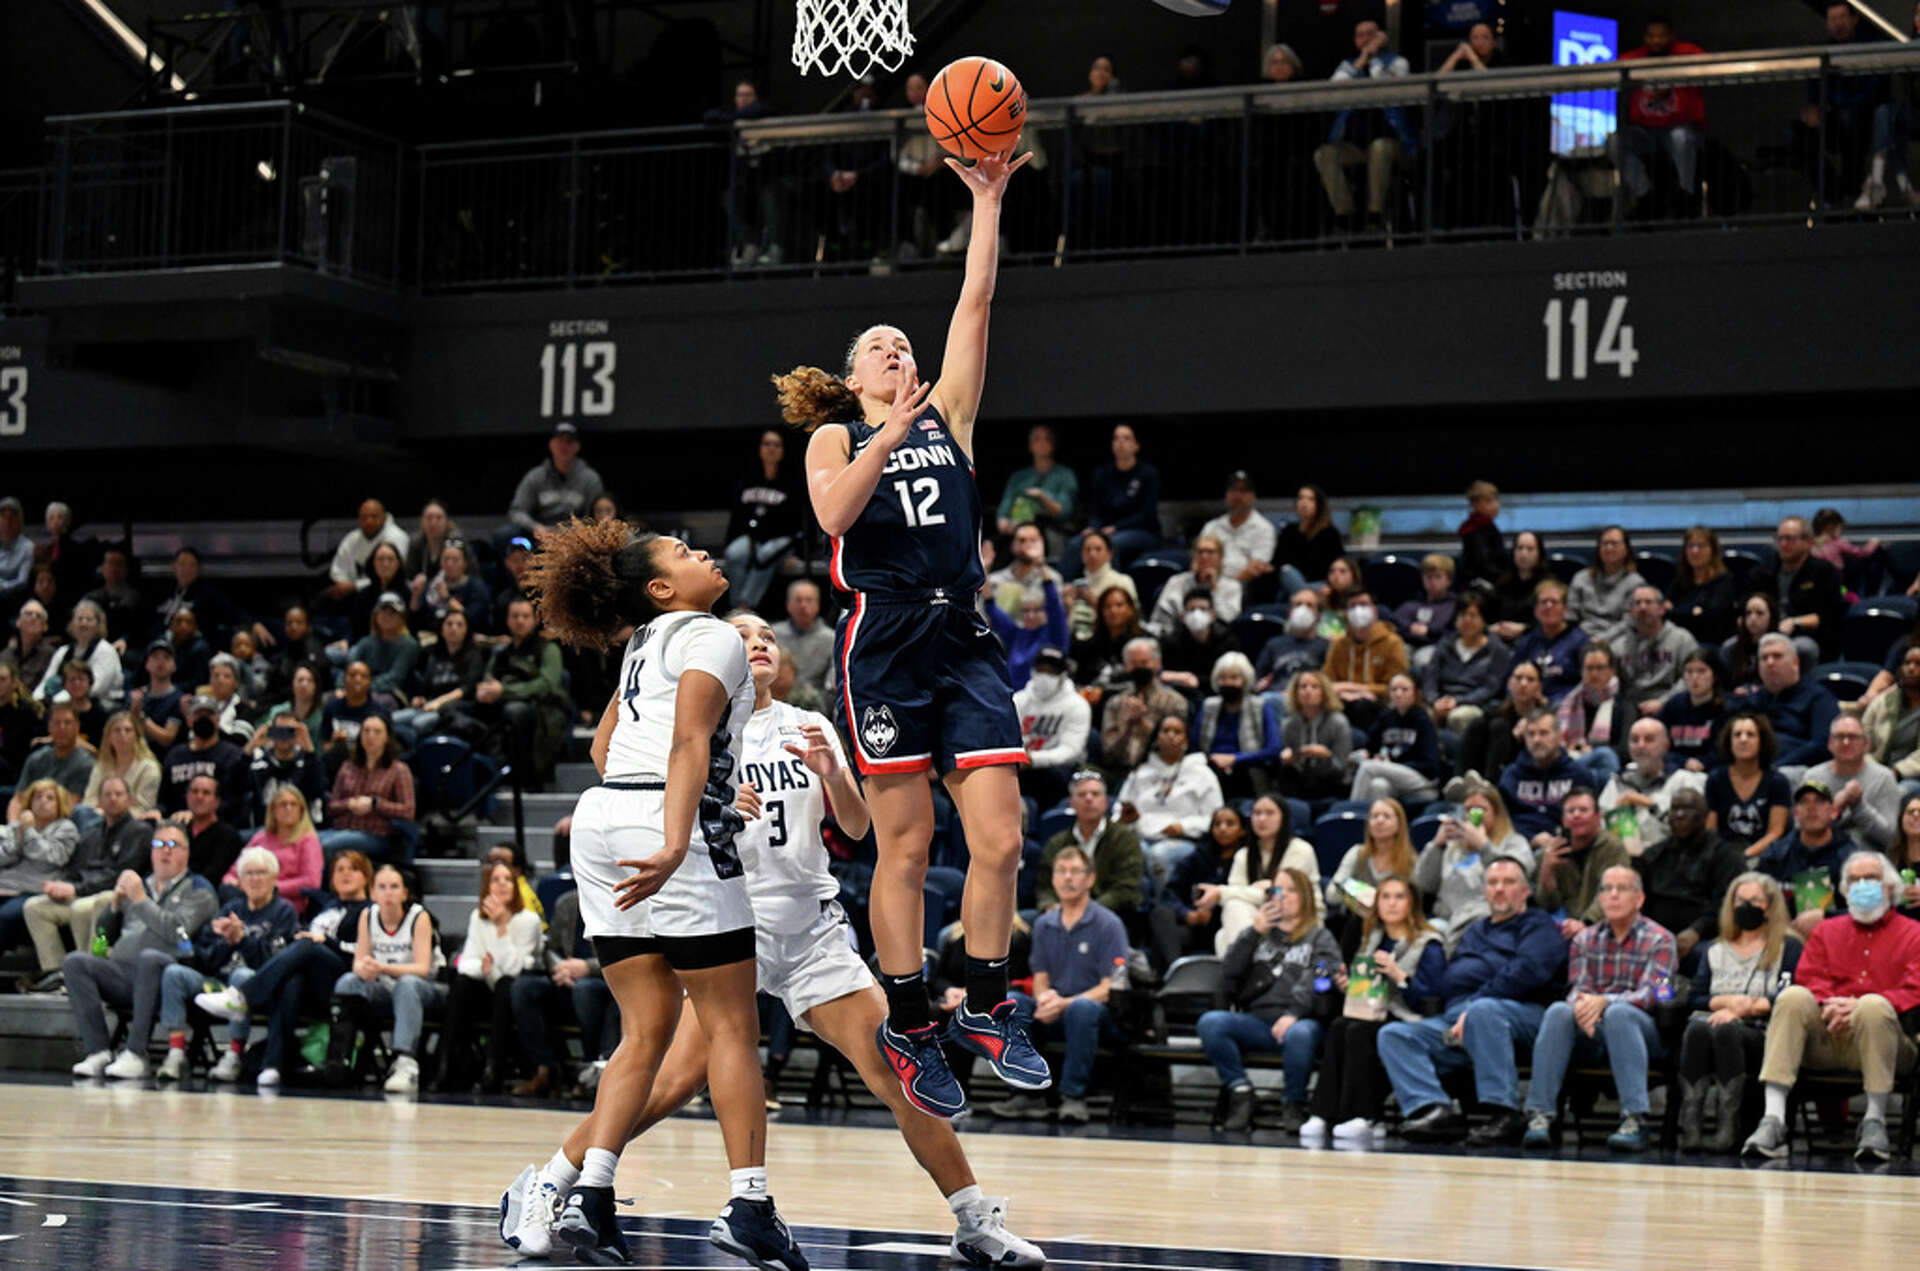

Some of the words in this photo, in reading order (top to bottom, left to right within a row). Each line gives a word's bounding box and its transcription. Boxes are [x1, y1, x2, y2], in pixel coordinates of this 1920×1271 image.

[1553, 270, 1627, 290] SECTION
[549, 319, 609, 337] SECTION
[1543, 296, 1639, 380] 114
[0, 366, 28, 436] 3
[540, 341, 616, 418] 113
[881, 445, 956, 474] CONN
[893, 477, 947, 527] 12
[623, 659, 646, 722] 4
[766, 800, 788, 848] 3
